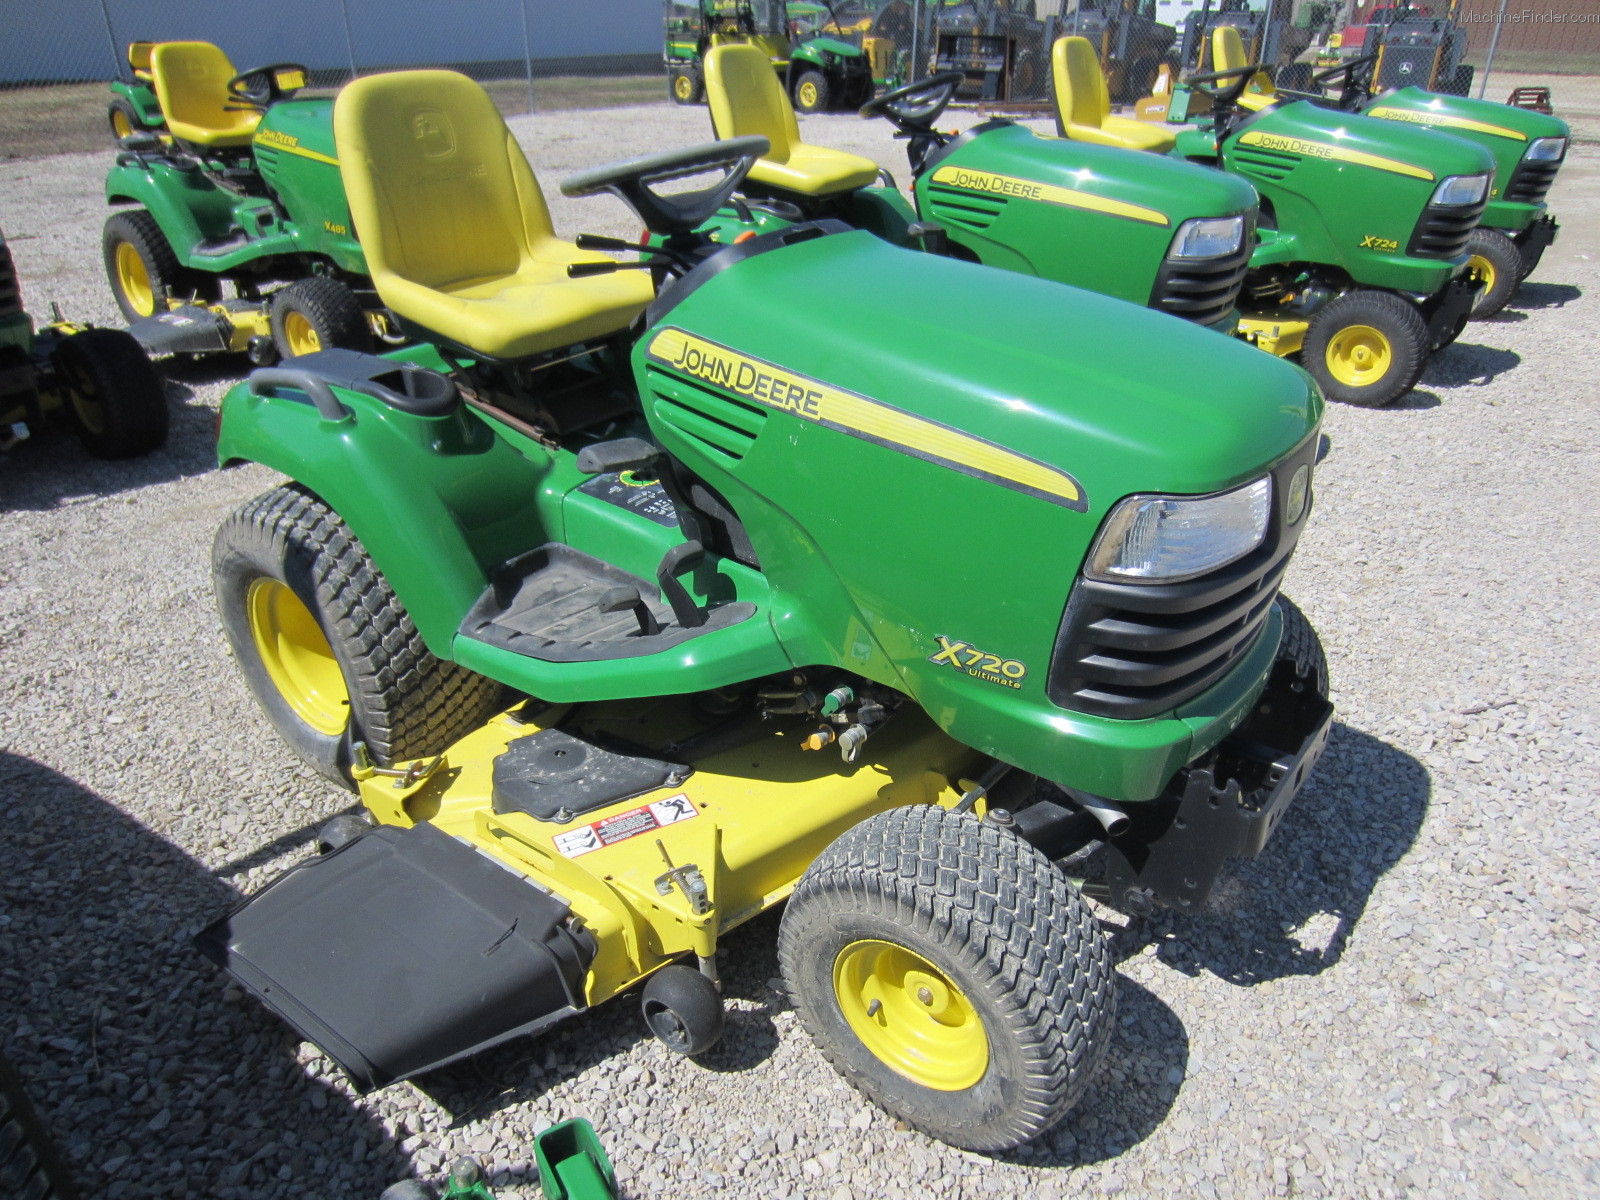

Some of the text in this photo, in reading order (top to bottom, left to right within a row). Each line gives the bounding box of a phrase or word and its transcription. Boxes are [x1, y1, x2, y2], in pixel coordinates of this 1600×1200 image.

[1381, 109, 1447, 125] JOHN DEERE
[276, 132, 298, 146] DEERE
[1255, 134, 1334, 158] JOHN DEERE
[949, 171, 1042, 199] JOHN DEERE
[1360, 235, 1398, 249] X724
[673, 341, 823, 417] JOHN DEERE
[931, 636, 1026, 679] X720
[968, 668, 1021, 689] Ultimate
[608, 808, 643, 822] DANGER
